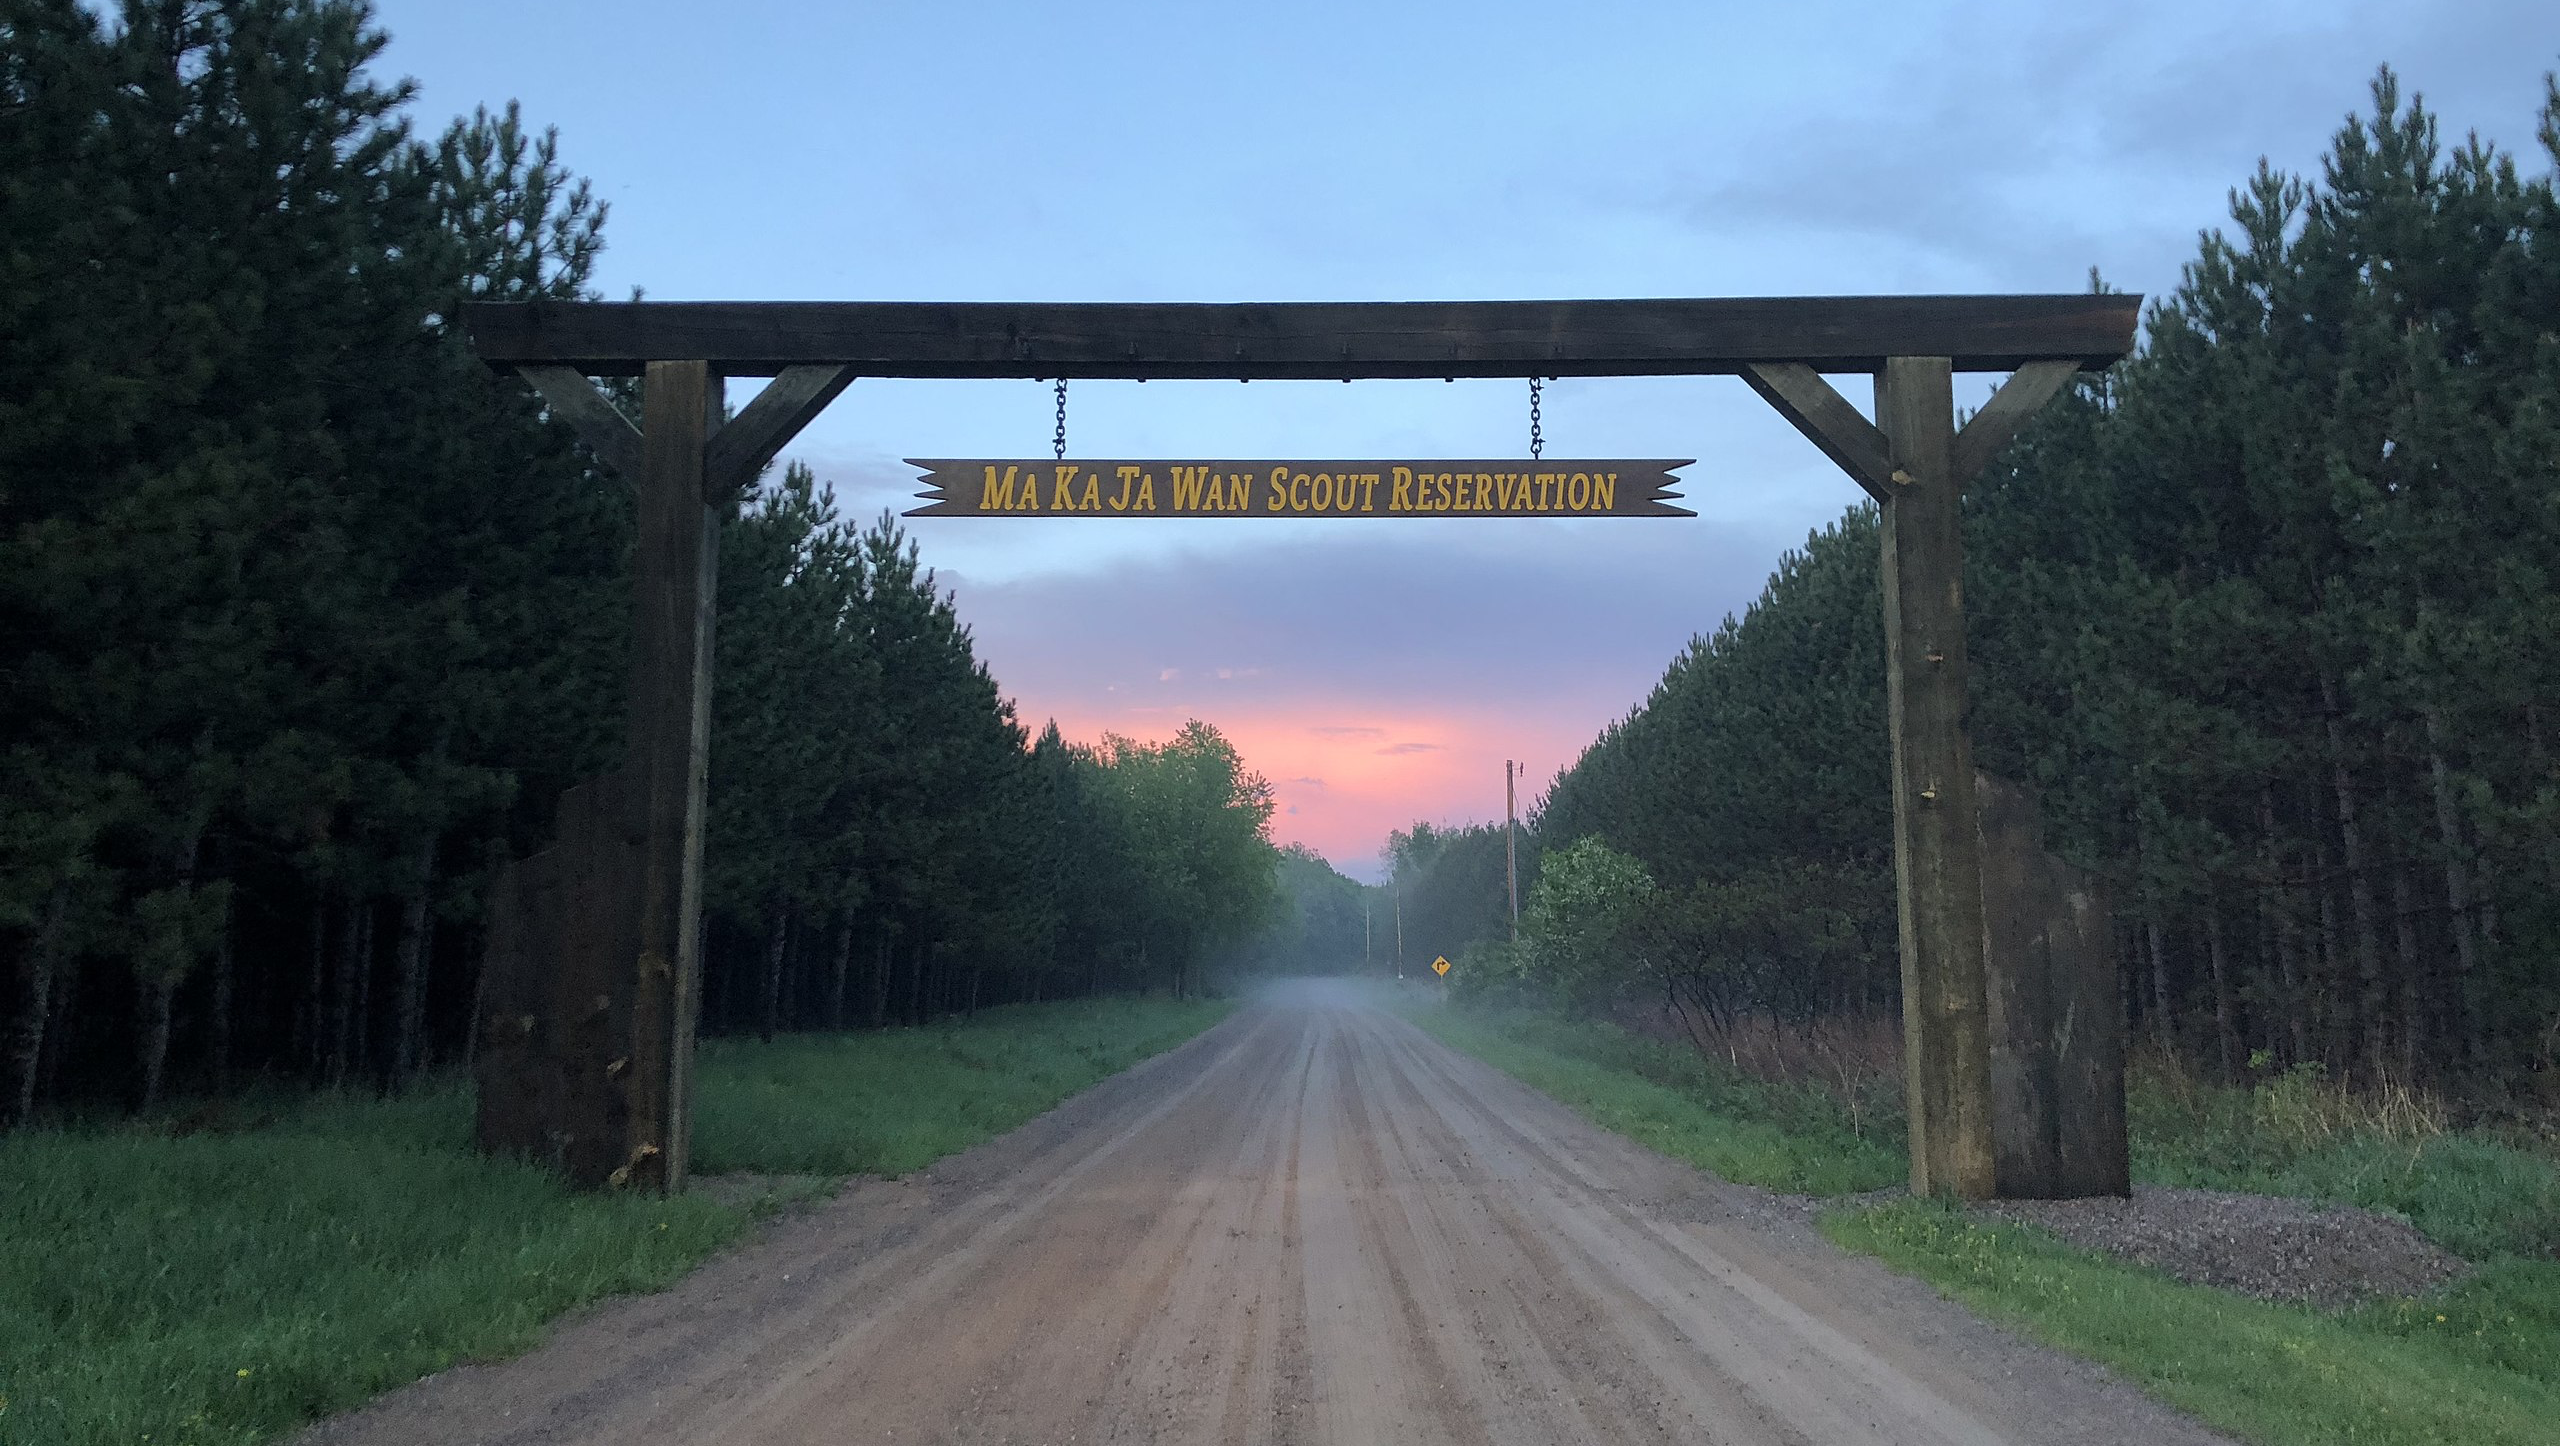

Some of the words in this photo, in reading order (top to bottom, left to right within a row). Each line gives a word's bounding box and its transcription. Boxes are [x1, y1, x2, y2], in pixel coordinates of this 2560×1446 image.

[980, 466, 1039, 512] MA
[1051, 466, 1102, 512] KA
[1108, 466, 1155, 512] JA
[1171, 466, 1253, 512] WAN
[1267, 467, 1380, 512] SCOUT
[1390, 466, 1617, 512] RESERVATION
